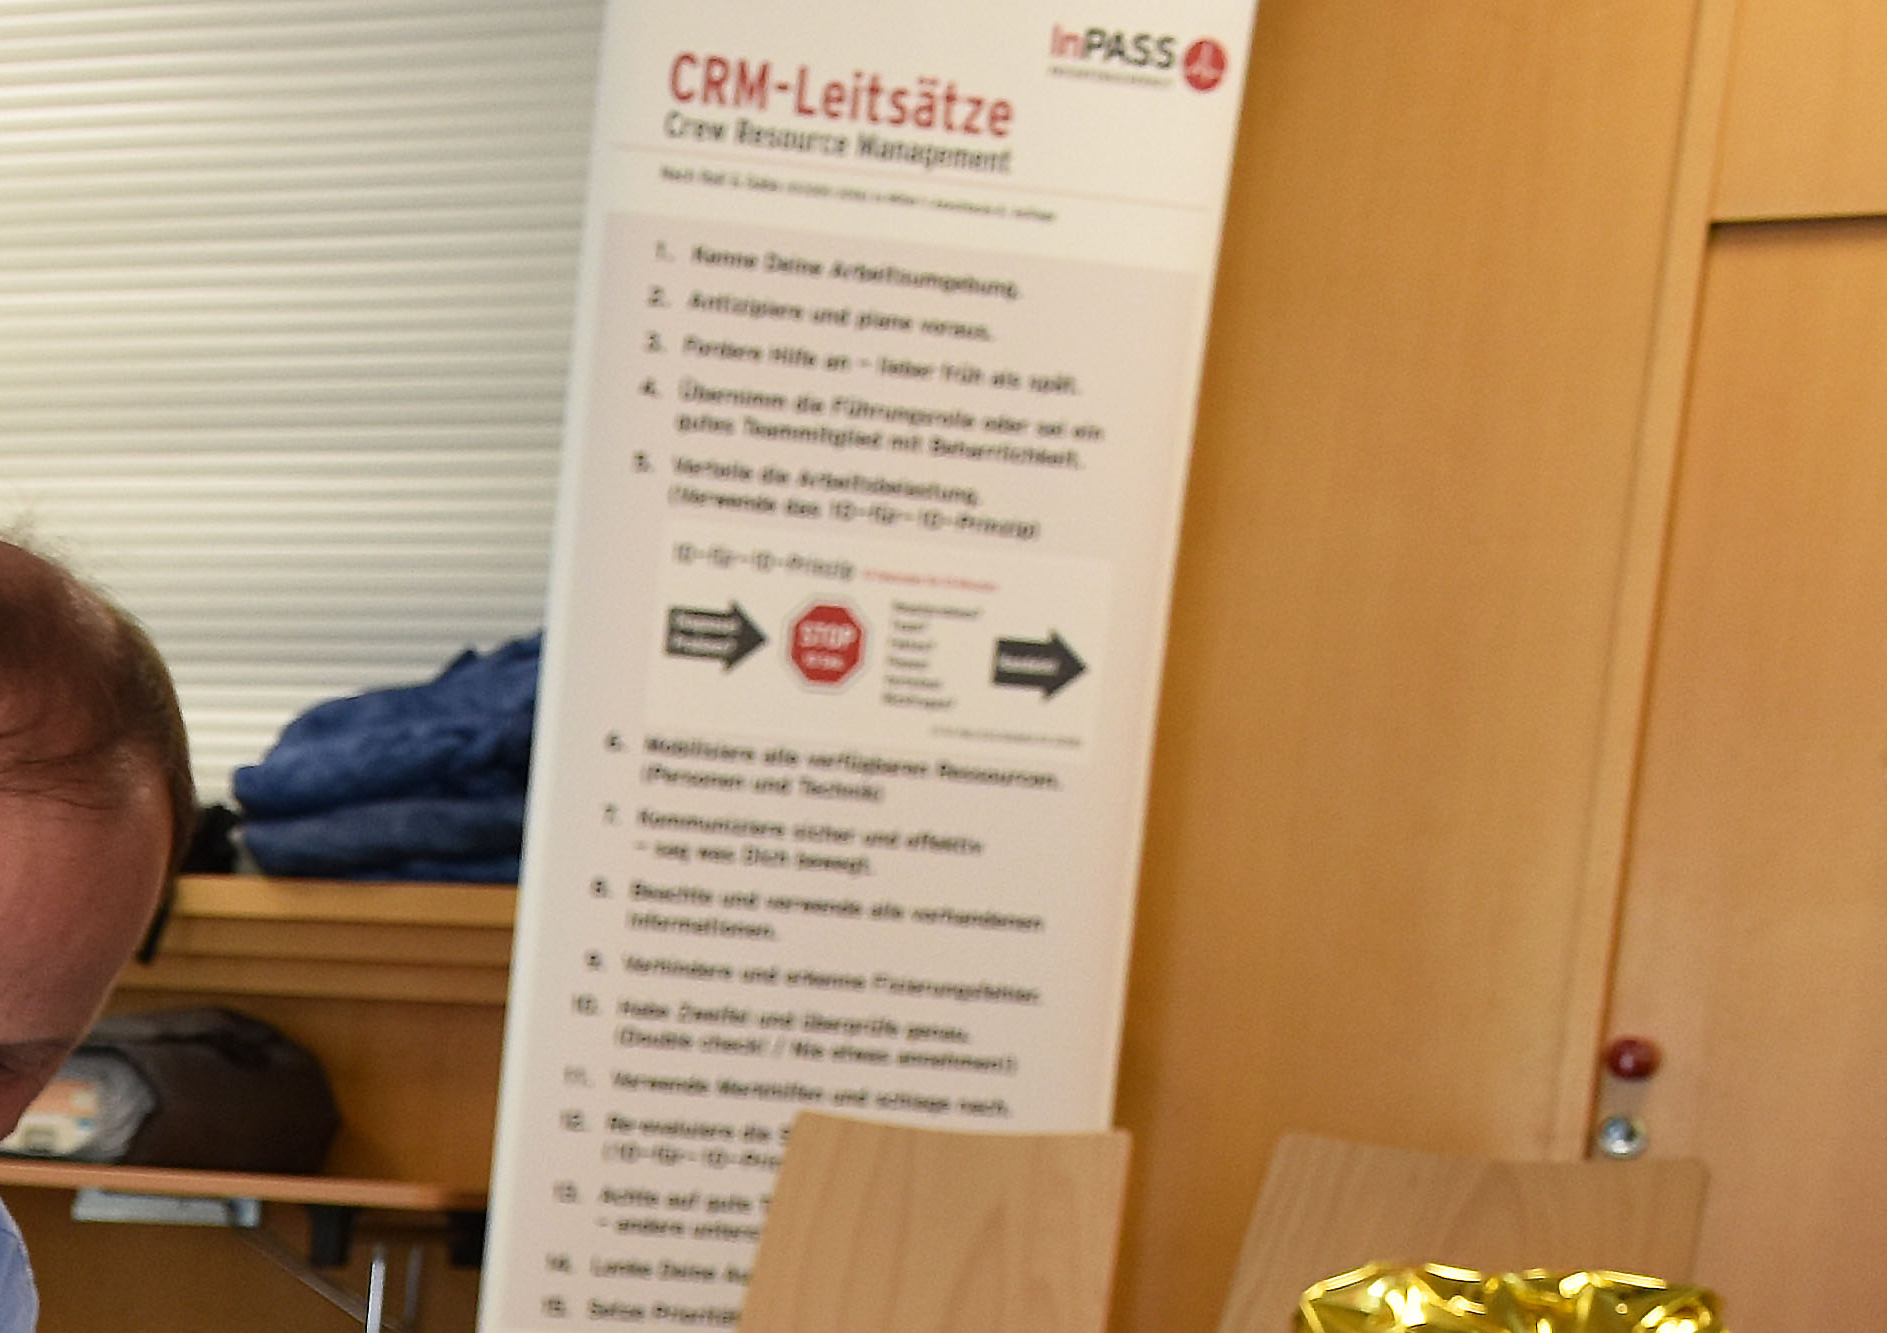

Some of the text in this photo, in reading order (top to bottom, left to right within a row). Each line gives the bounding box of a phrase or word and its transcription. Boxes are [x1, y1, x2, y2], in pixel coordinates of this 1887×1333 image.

[1049, 24, 1177, 69] InPASS
[669, 50, 1014, 138] CRM-Leitsätze
[665, 110, 1012, 173] Crew Resource Management
[811, 306, 850, 324] und
[799, 620, 858, 648] STOP
